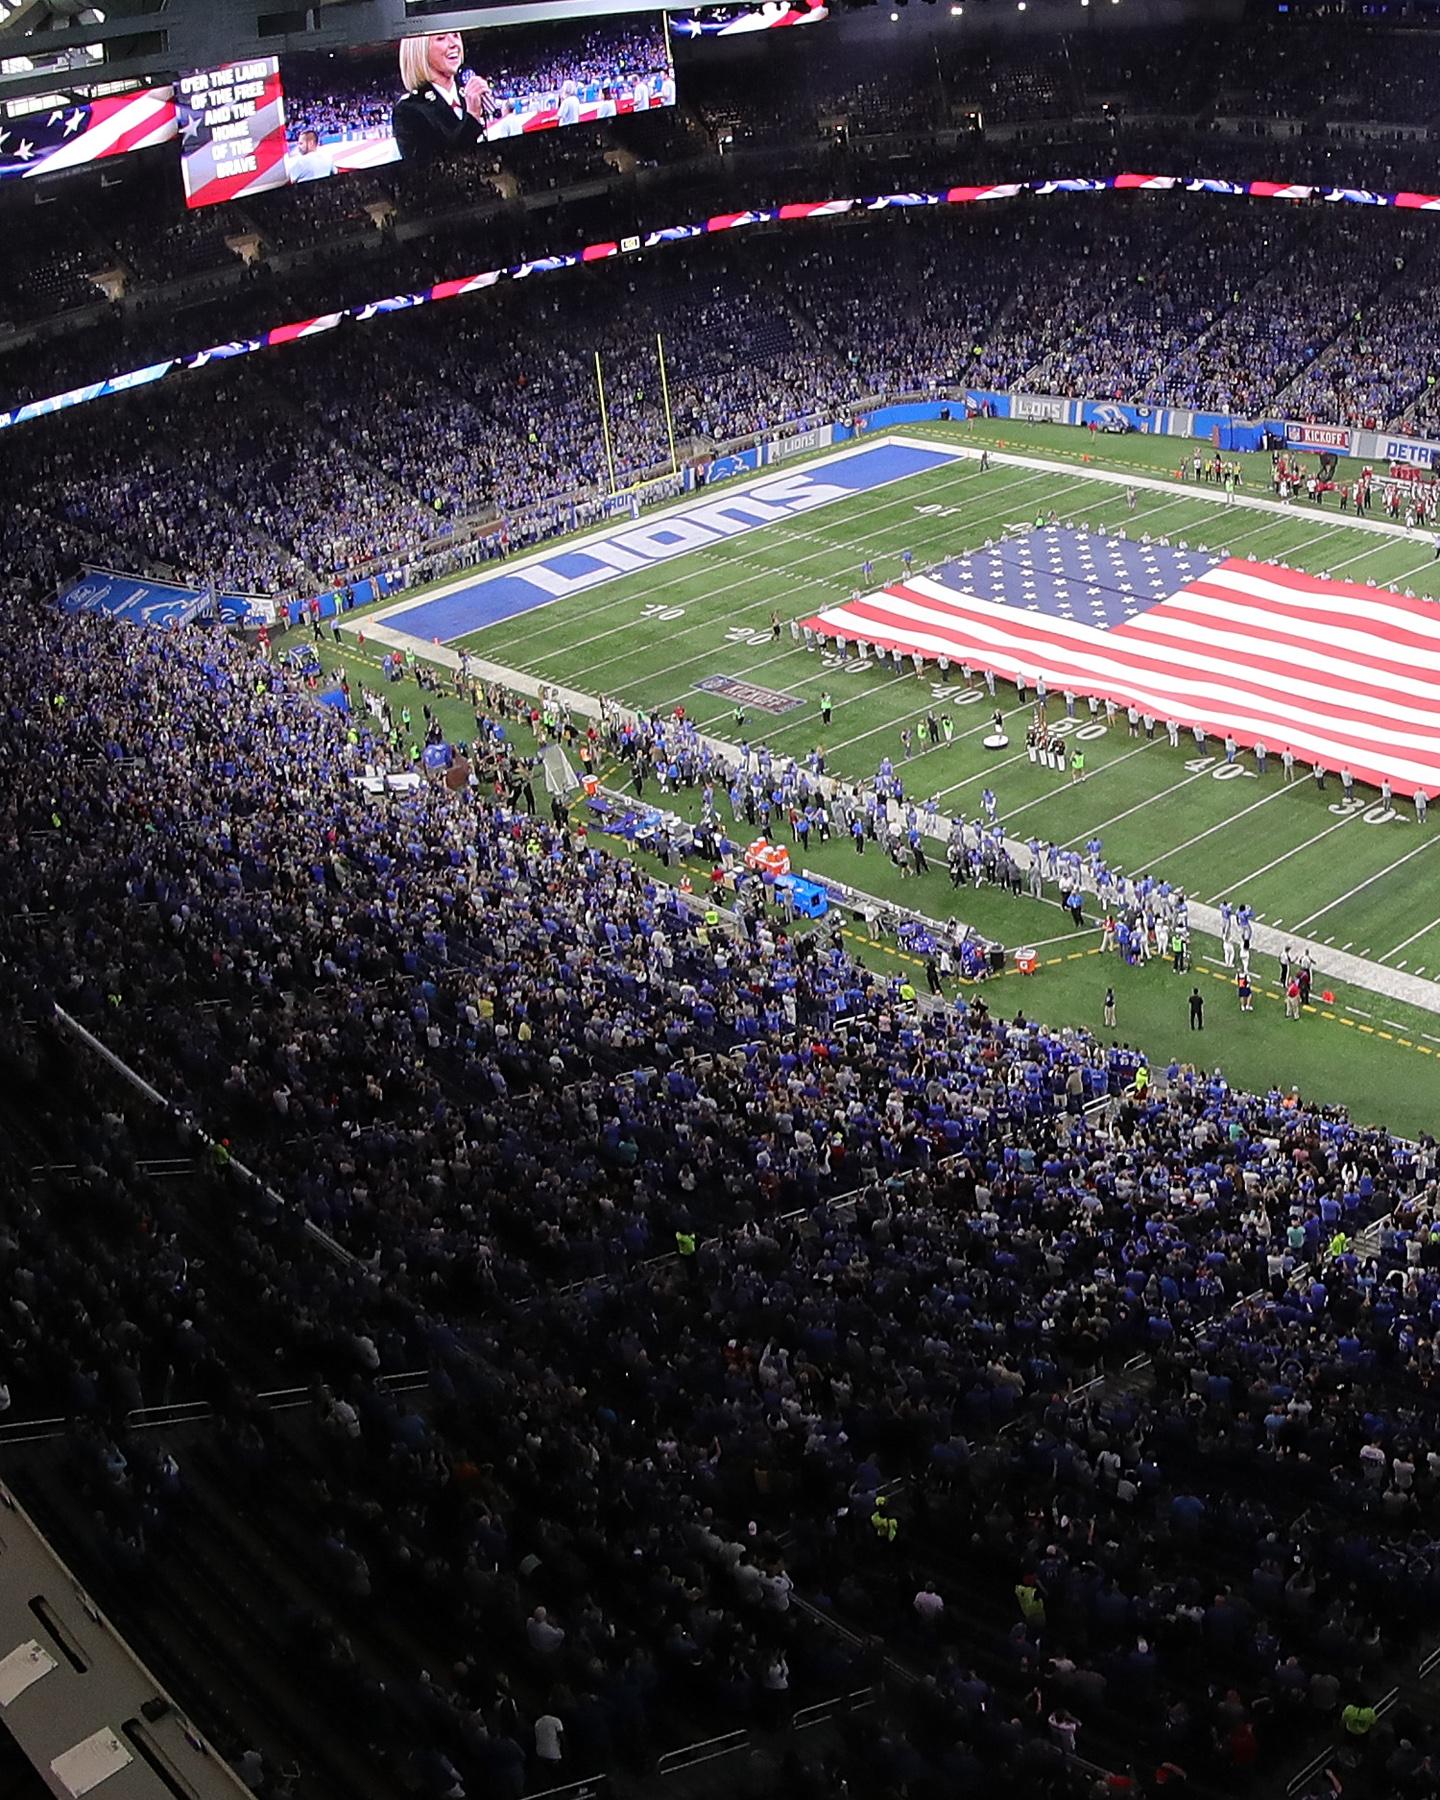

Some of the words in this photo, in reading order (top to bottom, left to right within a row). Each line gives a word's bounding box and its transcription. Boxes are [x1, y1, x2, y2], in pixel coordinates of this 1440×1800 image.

[209, 69, 234, 88] THE
[235, 62, 267, 82] LAND
[190, 93, 208, 110] OF
[208, 87, 233, 106] THE
[234, 81, 265, 100] FREE
[204, 107, 231, 126] AND
[231, 101, 256, 119] THE
[212, 120, 249, 142] HOME
[211, 143, 228, 160] OF
[228, 138, 253, 157] THE
[216, 155, 257, 179] BRAVE
[1018, 399, 1062, 418] LIONS
[784, 432, 815, 452] LIONS
[1305, 429, 1342, 445] KICKOFF
[505, 474, 861, 597] LIONS
[640, 604, 685, 621] 10
[724, 627, 773, 646] 20
[930, 685, 984, 705] 40
[1050, 717, 1108, 740] 50
